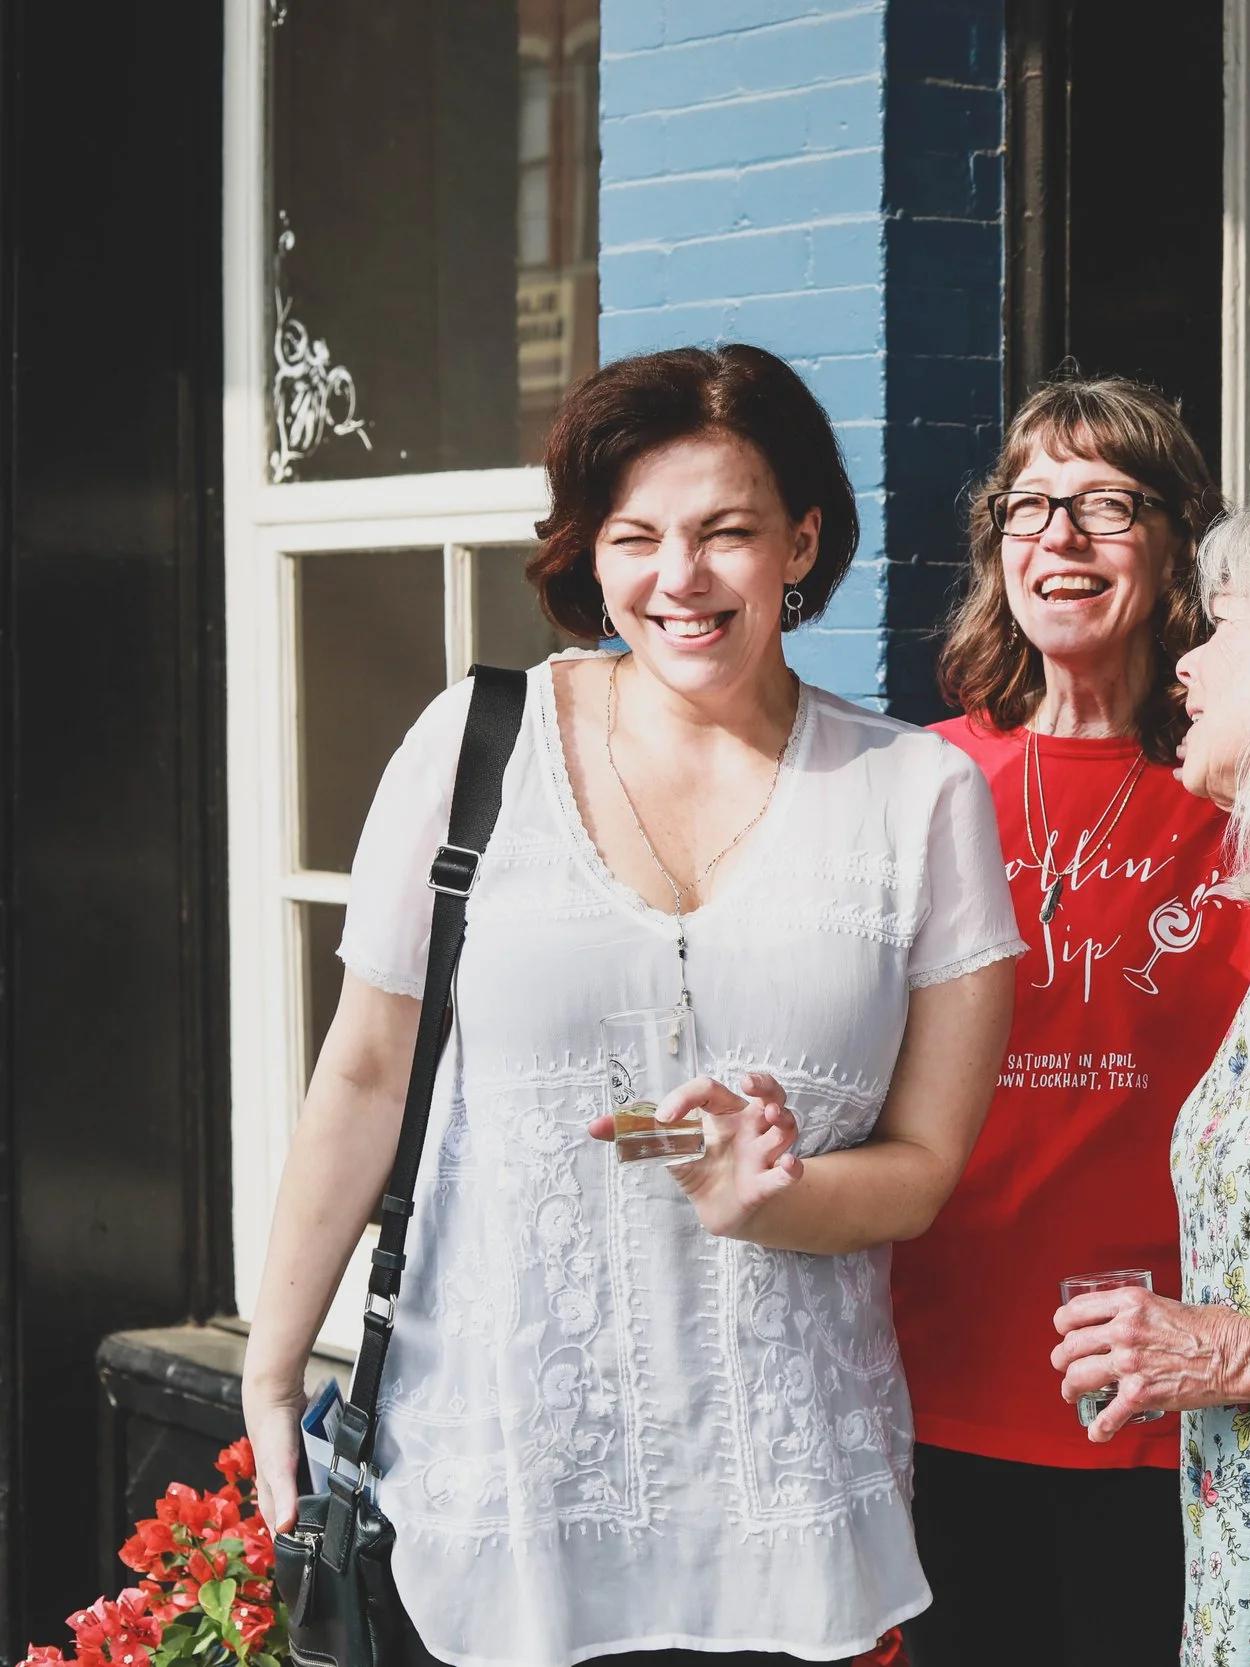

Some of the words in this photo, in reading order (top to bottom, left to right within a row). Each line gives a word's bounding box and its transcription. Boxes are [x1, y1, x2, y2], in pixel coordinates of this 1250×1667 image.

[1008, 1053, 1071, 1070] SATURDAY
[1079, 1054, 1092, 1069] IN
[1100, 1052, 1136, 1069] APRIL
[1030, 1072, 1101, 1090] LOCKHART,
[1108, 1071, 1149, 1090] TEXAS
